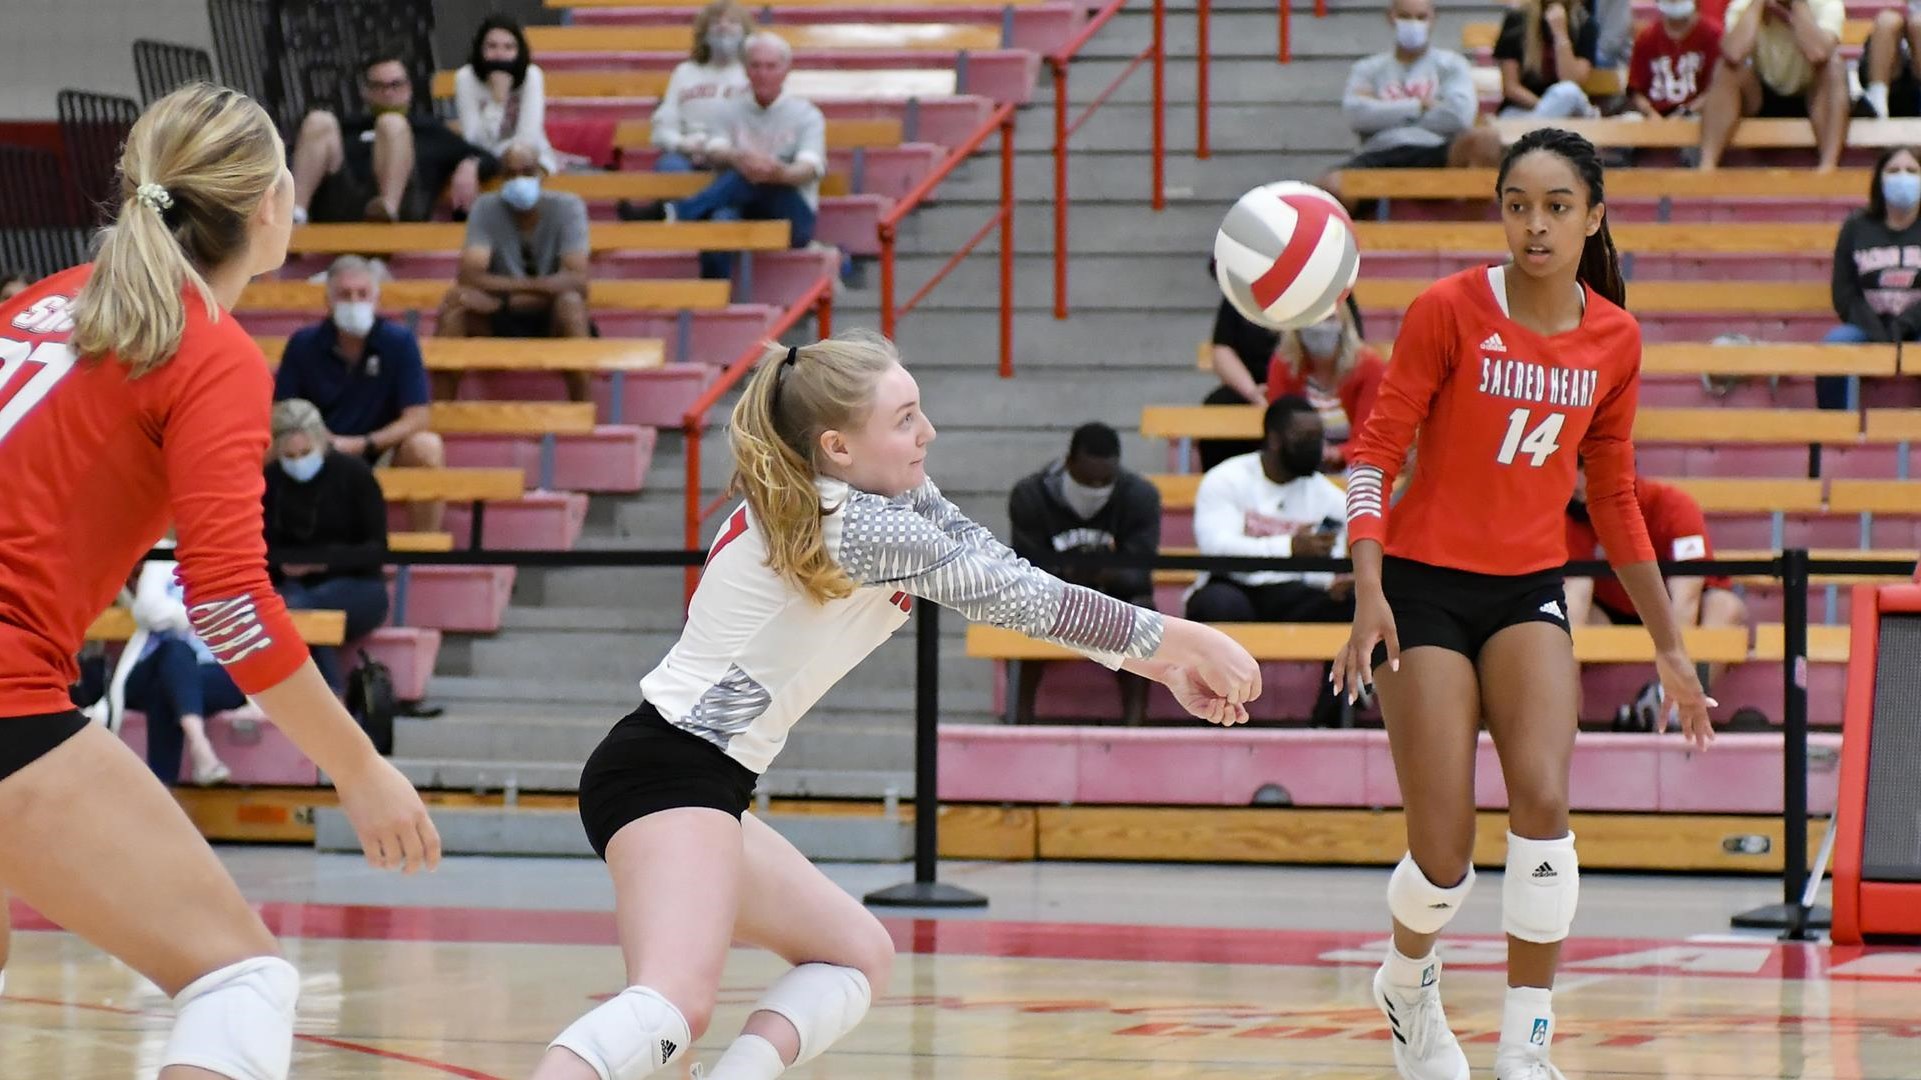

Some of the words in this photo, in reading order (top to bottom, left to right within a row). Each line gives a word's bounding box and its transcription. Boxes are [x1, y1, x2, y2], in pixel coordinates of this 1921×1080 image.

[1479, 357, 1545, 402] SACRED
[1549, 367, 1598, 407] HEART
[1497, 408, 1566, 466] 14
